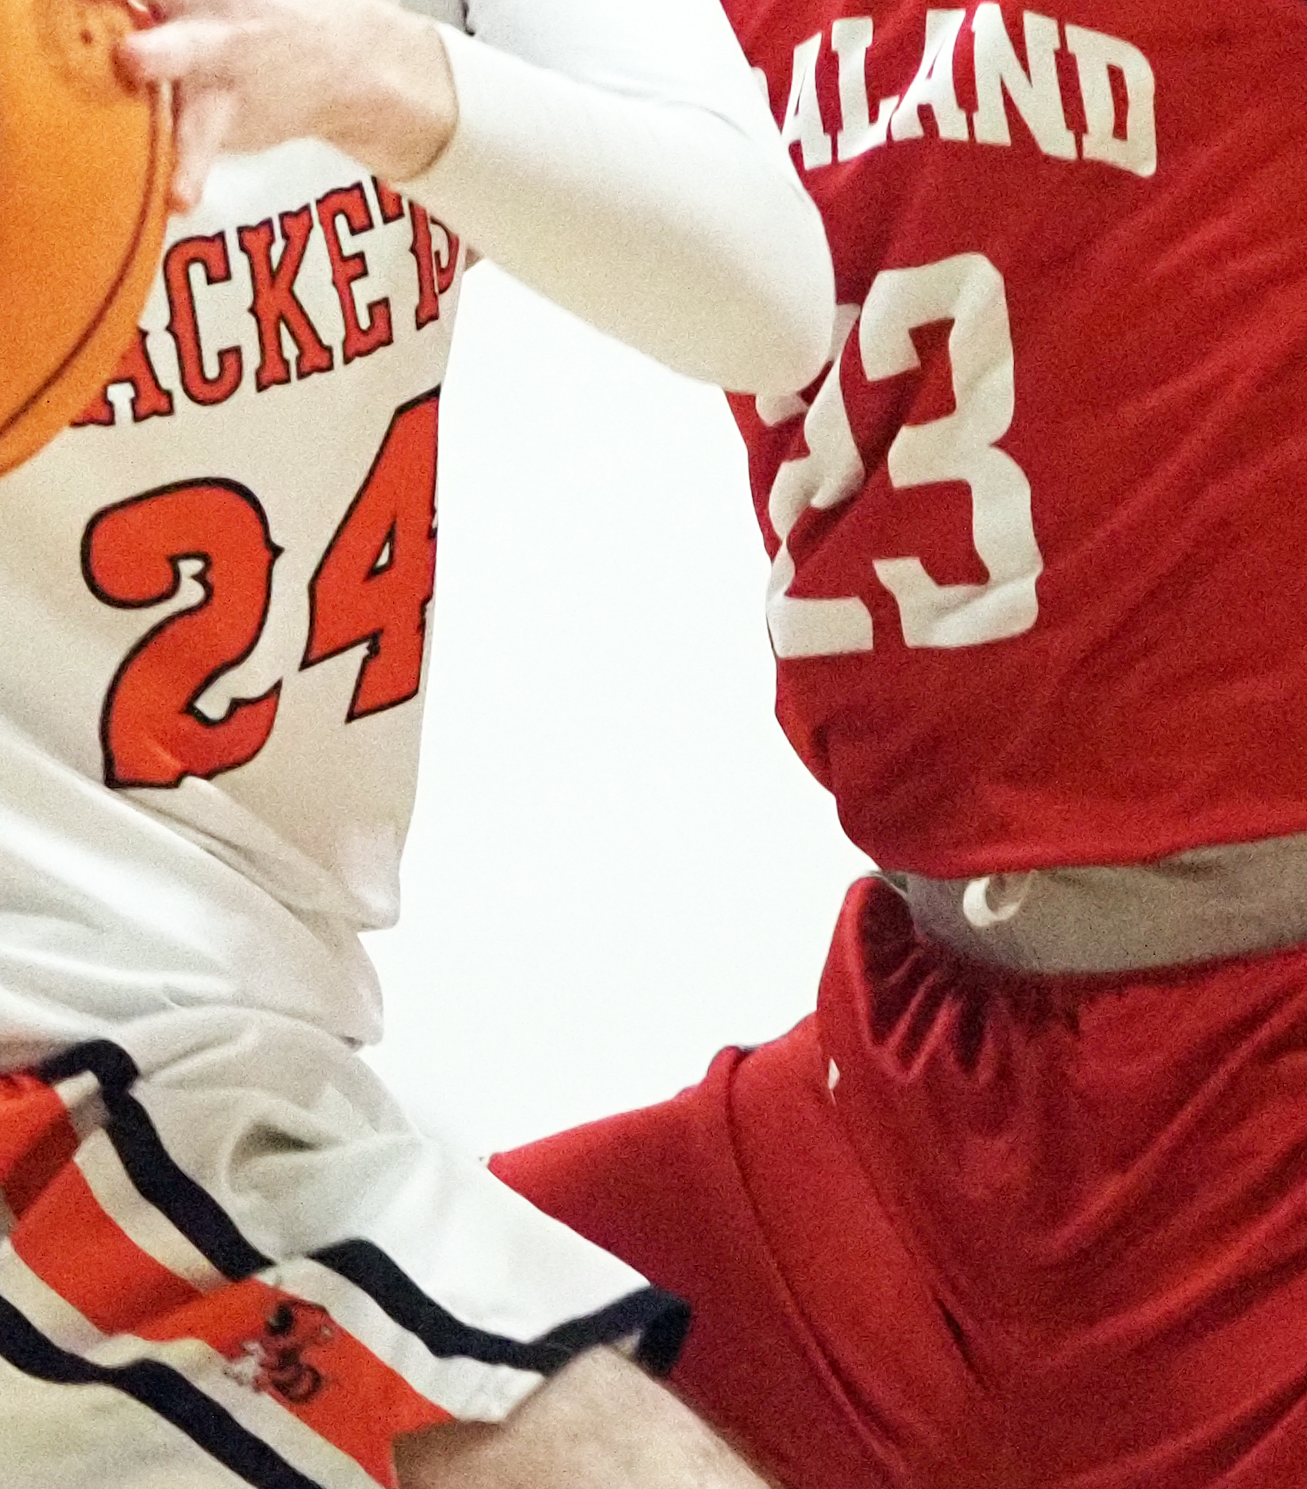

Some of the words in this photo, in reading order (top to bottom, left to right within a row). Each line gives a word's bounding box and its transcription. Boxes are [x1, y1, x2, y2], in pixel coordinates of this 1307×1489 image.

[751, 1, 1158, 177] ALAND
[70, 175, 460, 425] ACKET
[765, 252, 1044, 658] 23
[80, 385, 442, 789] 24
